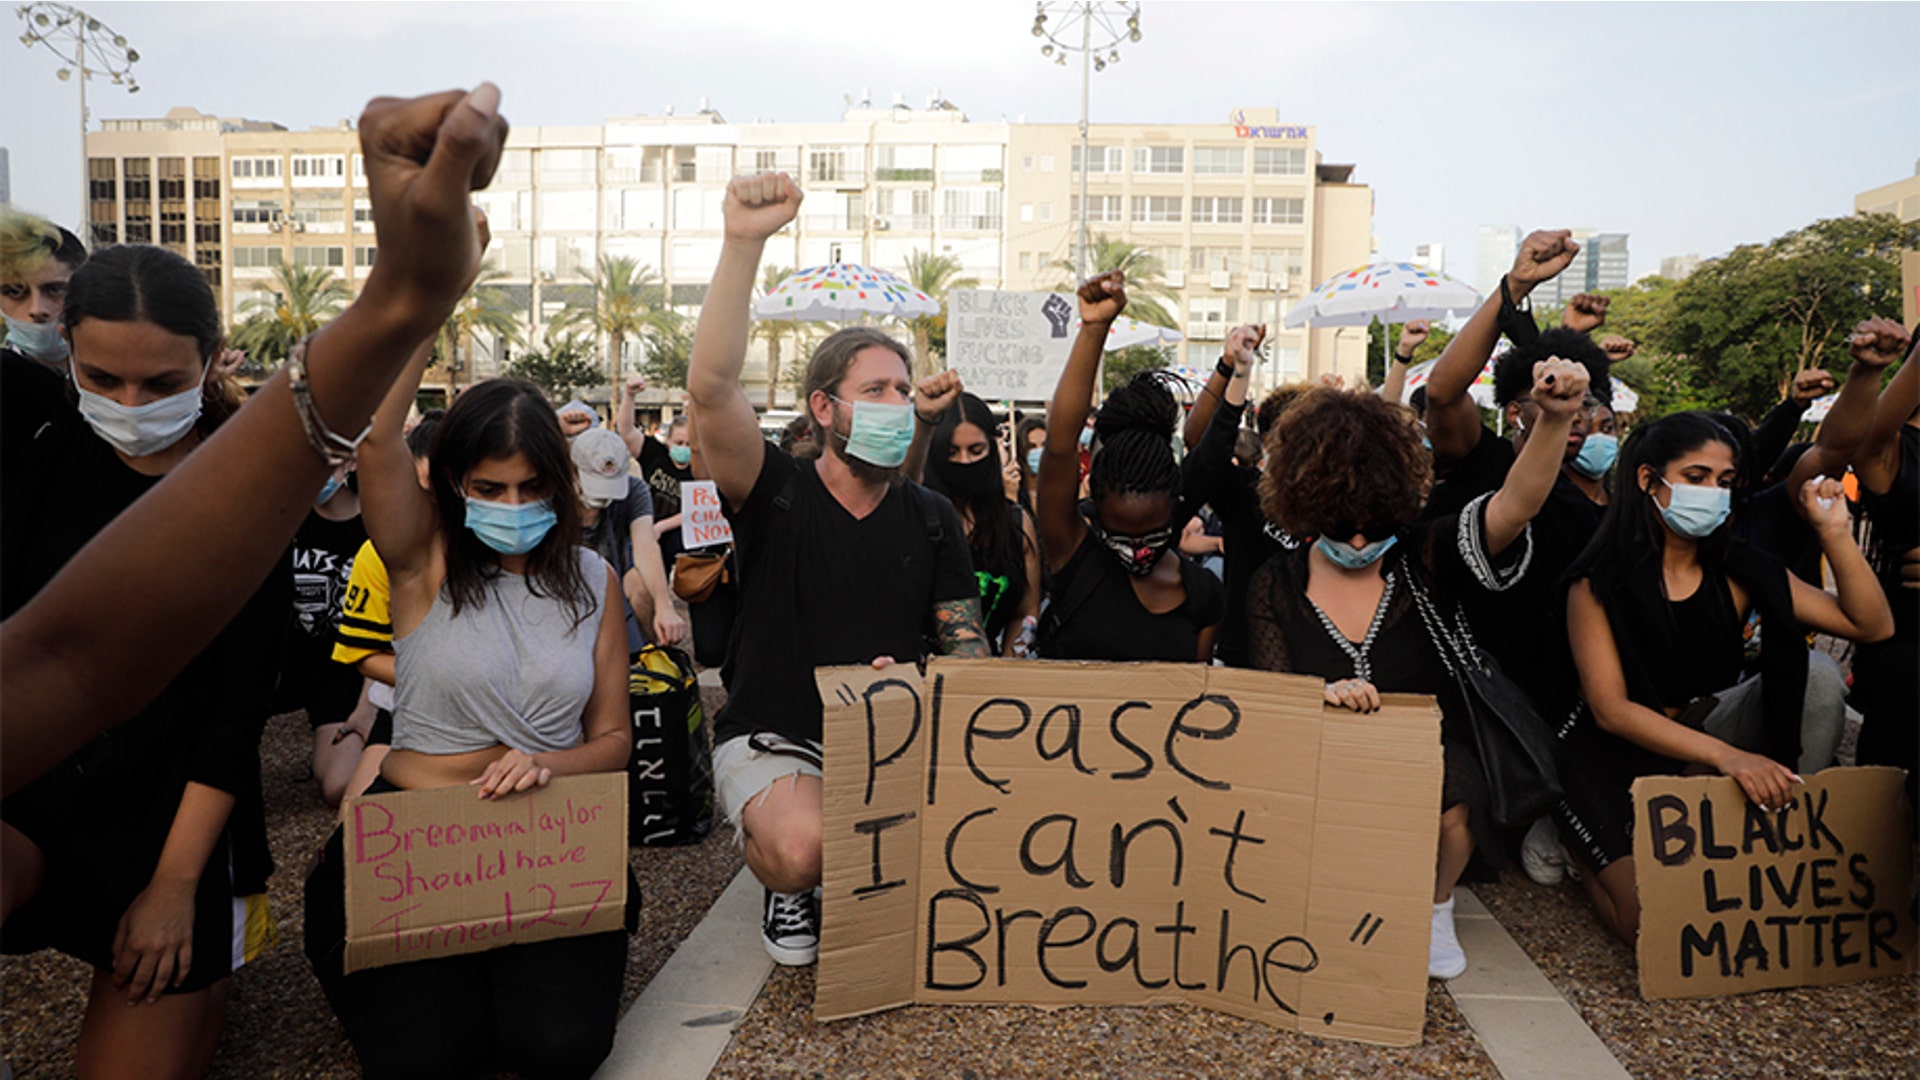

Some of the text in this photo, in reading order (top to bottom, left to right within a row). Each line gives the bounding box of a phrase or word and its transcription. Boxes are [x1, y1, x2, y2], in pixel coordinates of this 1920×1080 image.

[957, 291, 1028, 316] BLACK
[957, 316, 1025, 339] LIVES
[956, 340, 1044, 365] FUCKING
[345, 584, 370, 613] 91
[354, 788, 602, 864] Breonna Taylor
[851, 796, 1267, 904] I can't
[1647, 788, 1845, 867] BLACK
[374, 845, 587, 902] Should have
[1703, 853, 1876, 914] LIVES
[370, 879, 613, 953] Turned 27
[1681, 910, 1903, 978] MATTER
